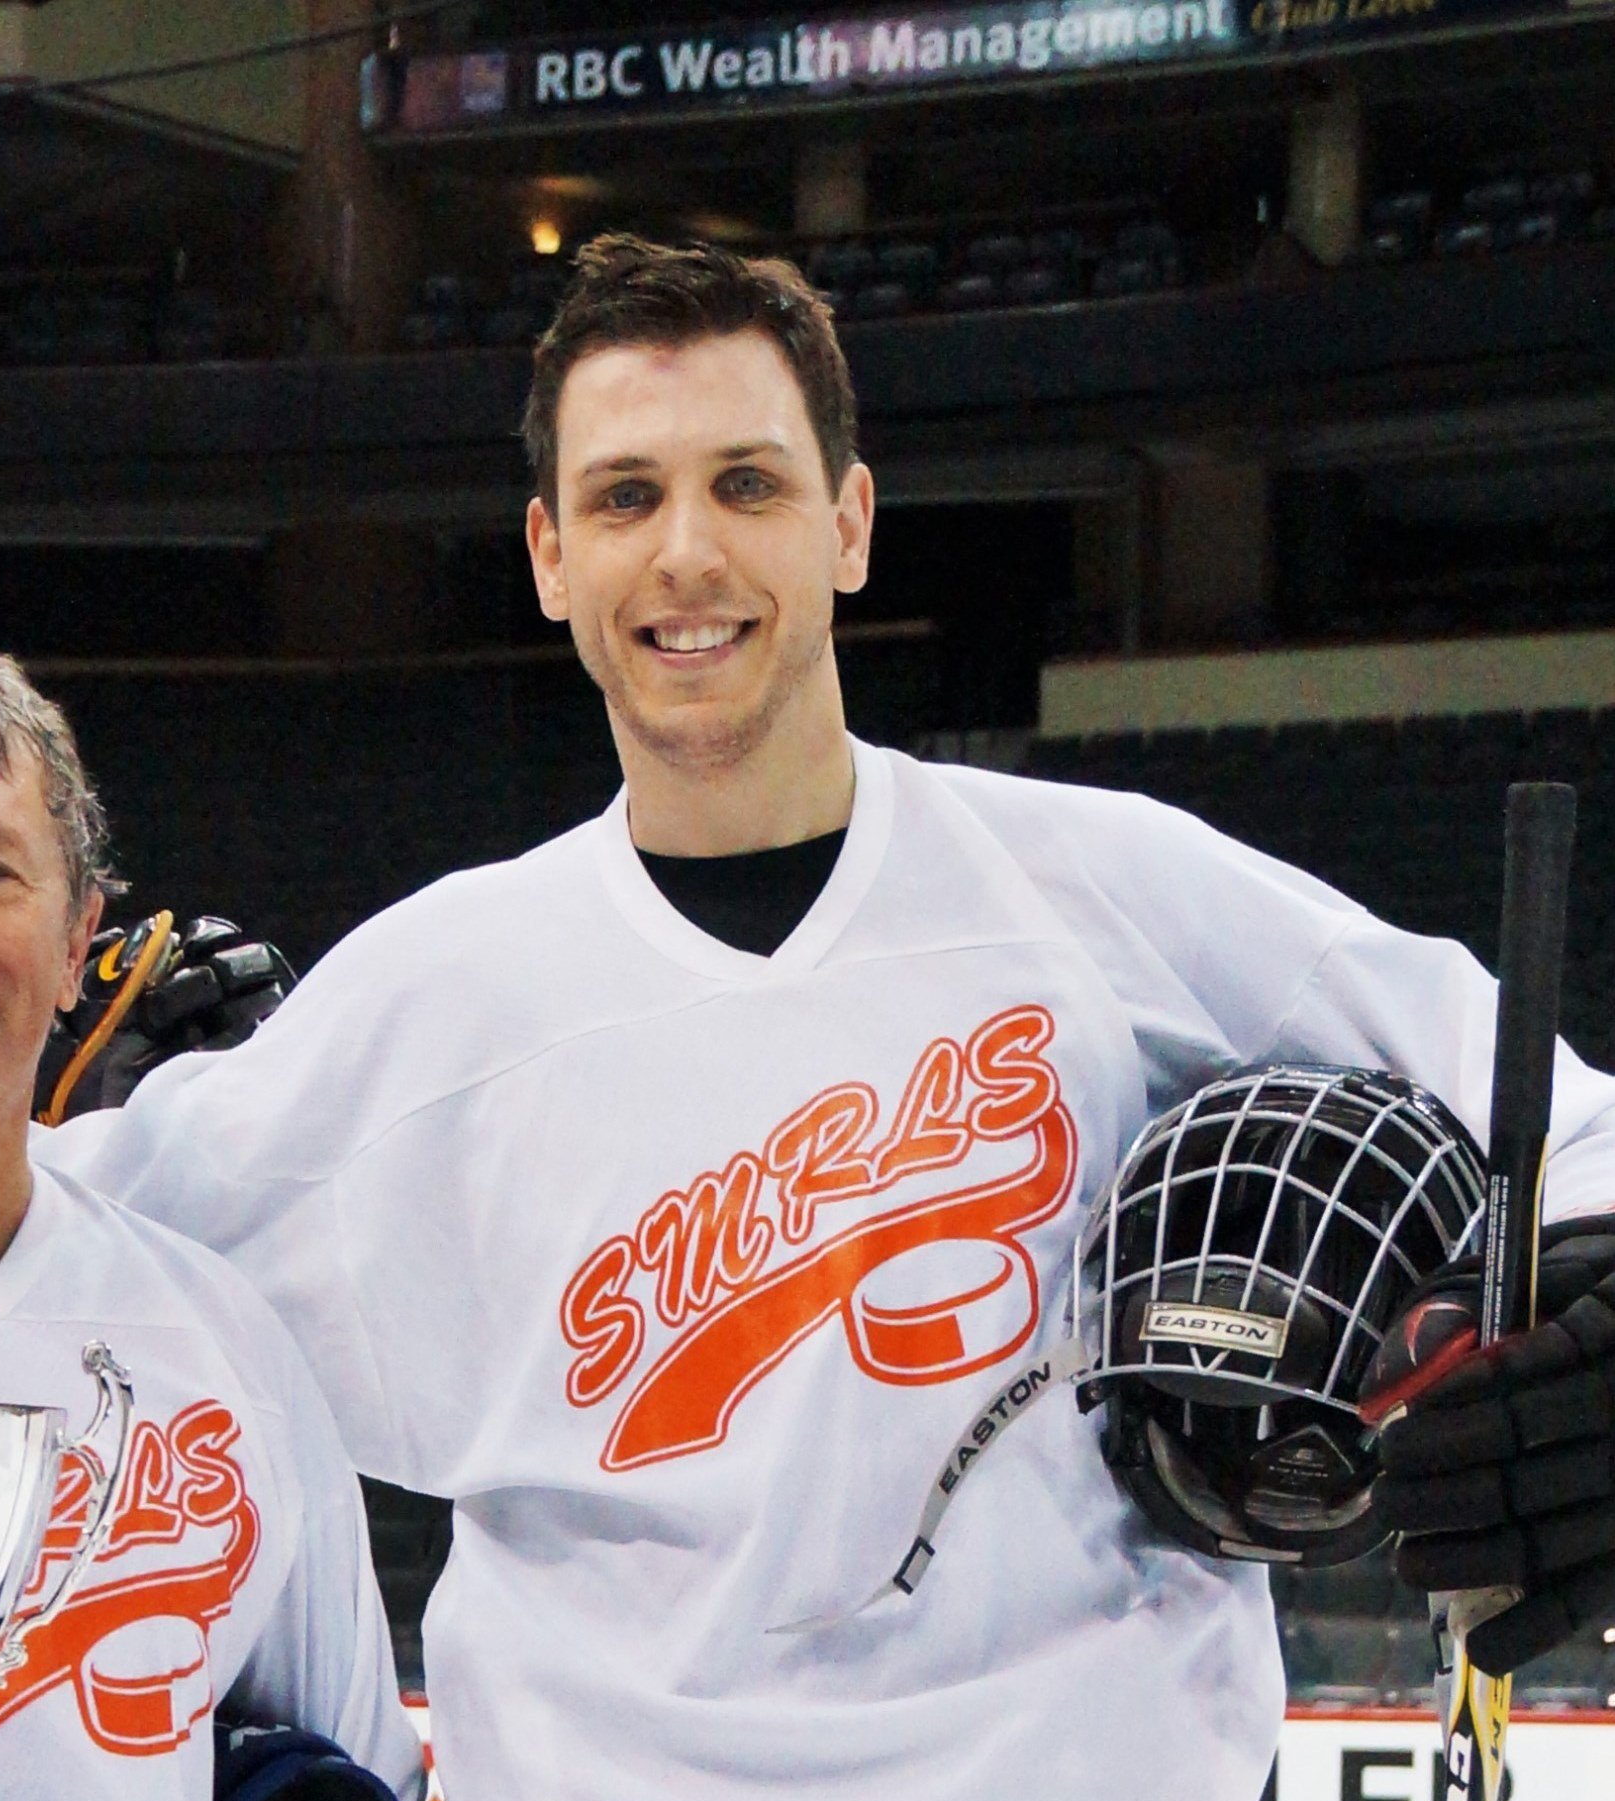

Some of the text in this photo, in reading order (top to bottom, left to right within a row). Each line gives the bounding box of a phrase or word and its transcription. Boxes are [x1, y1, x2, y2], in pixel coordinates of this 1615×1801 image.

[536, 0, 1231, 101] RBC Wealth Management
[560, 1004, 1060, 1408] SMRLS
[1153, 1315, 1270, 1342] EASTON
[937, 1361, 1053, 1494] EASTON
